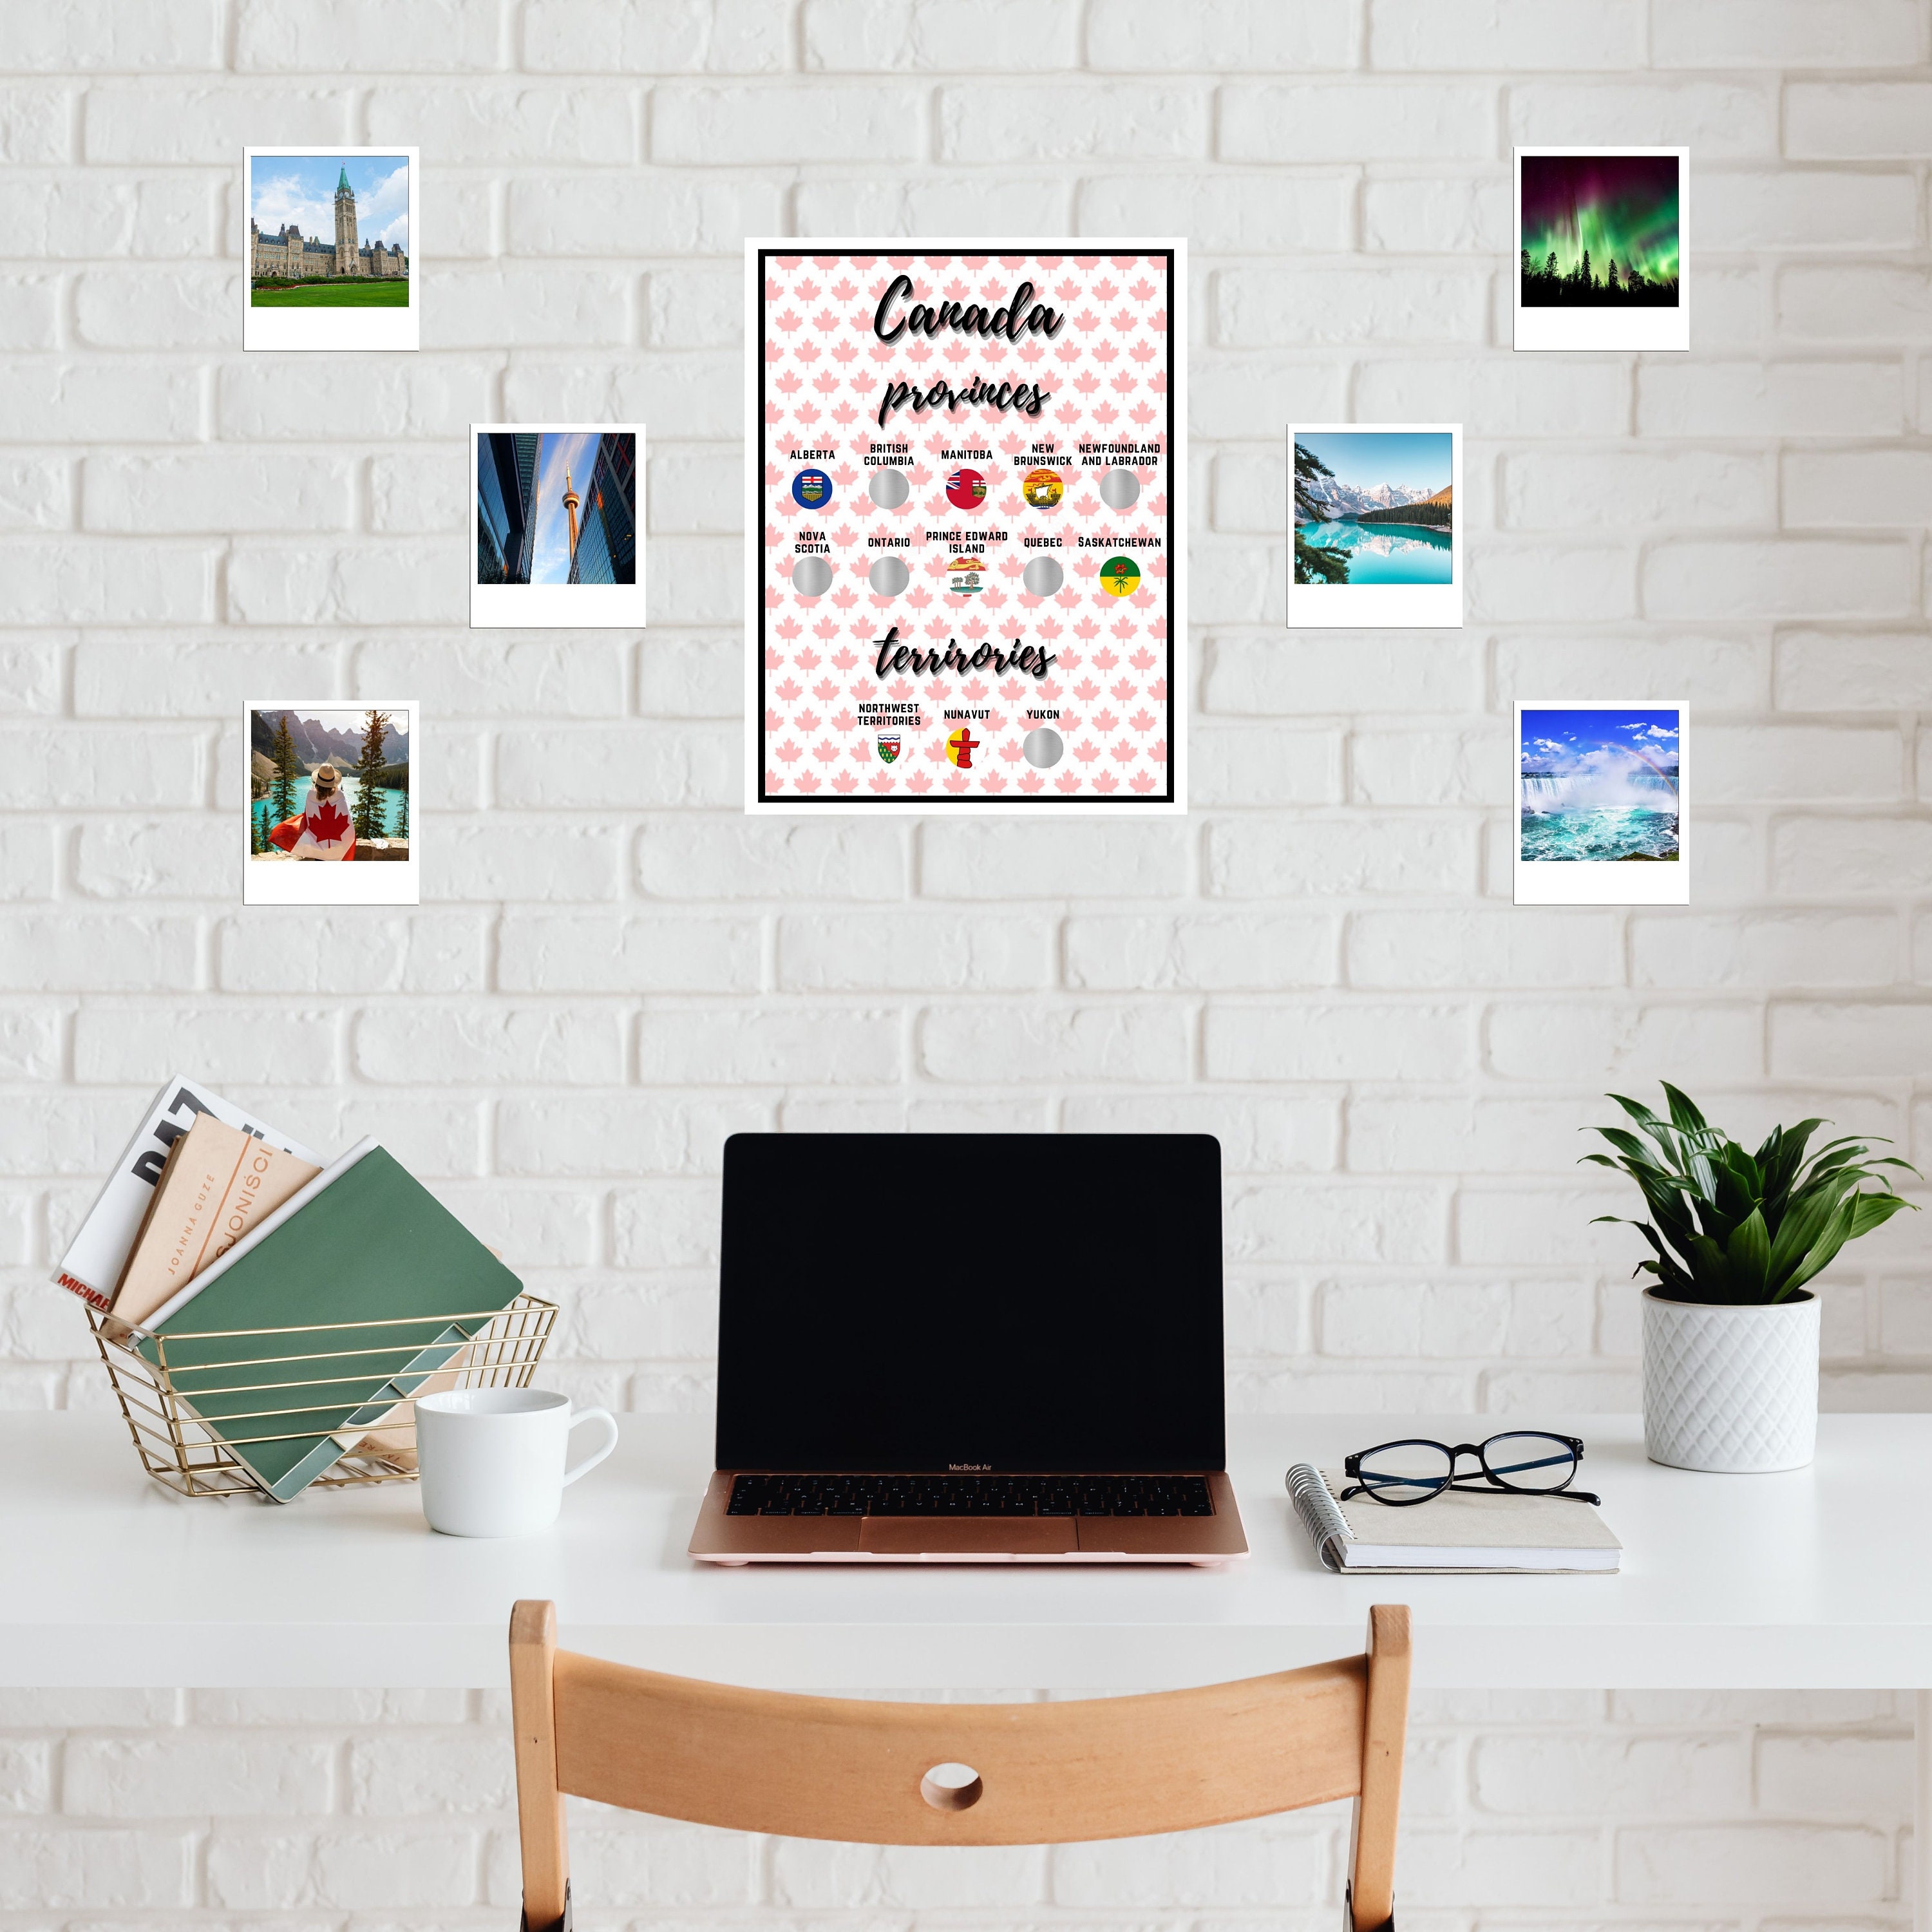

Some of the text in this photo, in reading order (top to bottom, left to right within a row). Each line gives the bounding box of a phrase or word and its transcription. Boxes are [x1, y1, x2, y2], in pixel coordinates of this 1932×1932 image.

[873, 274, 1066, 346] Canada
[878, 375, 1052, 430] provinces
[870, 444, 908, 453] BRITISH
[1032, 444, 1054, 453] NEW
[1079, 444, 1160, 453] NEWFOUNDLAND
[790, 450, 835, 460] ALBERTA
[941, 450, 993, 460] MANITOBA
[864, 456, 914, 466] COLUMBIA
[1014, 456, 1072, 466] BRUNSWICK
[1081, 456, 1158, 466] AND LABRADOR
[799, 531, 826, 541] NOVA
[926, 531, 1008, 541] PRINCE EDWARD
[868, 538, 910, 547] ONTARIO
[1024, 538, 1063, 548] QUEBEC
[1078, 536, 1161, 547] SASKATCHEWAN
[795, 544, 831, 553] SCOTIA
[949, 544, 985, 553] ISLAND
[859, 703, 920, 713] NORTHWEST
[944, 710, 990, 719] NUNAVUT
[1026, 710, 1059, 719] YUKON
[857, 715, 921, 726] TERRITORIES
[167, 1174, 214, 1275] JOANNA GUZE
